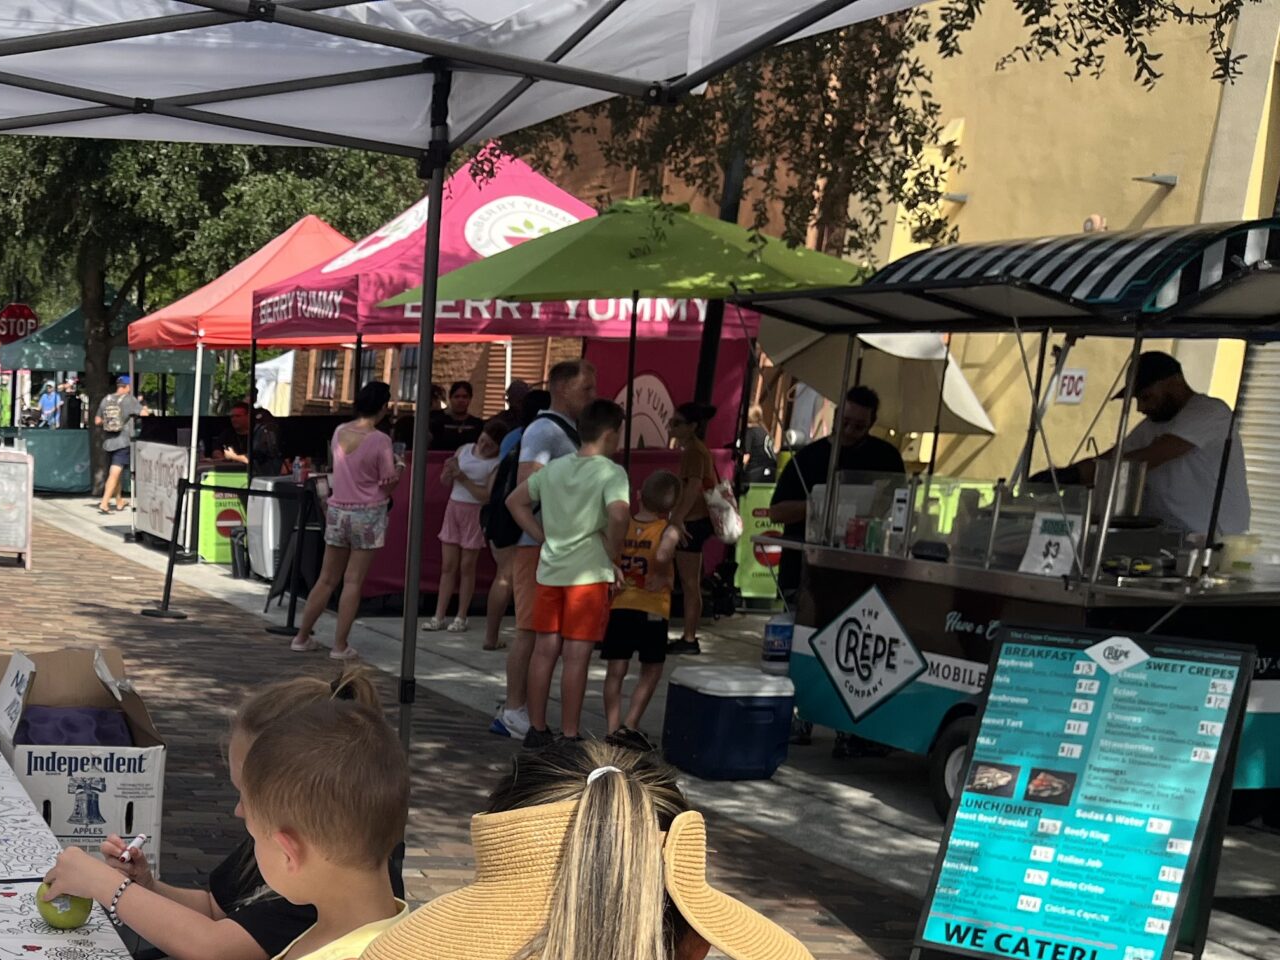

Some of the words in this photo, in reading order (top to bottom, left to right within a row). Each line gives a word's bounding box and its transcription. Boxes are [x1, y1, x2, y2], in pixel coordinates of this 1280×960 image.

[259, 292, 293, 325] BERRY
[296, 288, 343, 320] YUMMY
[1059, 374, 1084, 397] FDC
[861, 608, 880, 620] THE
[944, 610, 975, 632] Have
[1004, 646, 1077, 661] BREAKFAST
[928, 661, 986, 688] MOBILE
[1146, 661, 1187, 674] SWEET
[1188, 665, 1235, 679] CREPES
[844, 678, 884, 699] COMPANY
[25, 750, 149, 777] Independent
[959, 798, 1043, 818] UNCH/DINER
[72, 827, 104, 836] APPLES
[944, 922, 988, 949] WE
